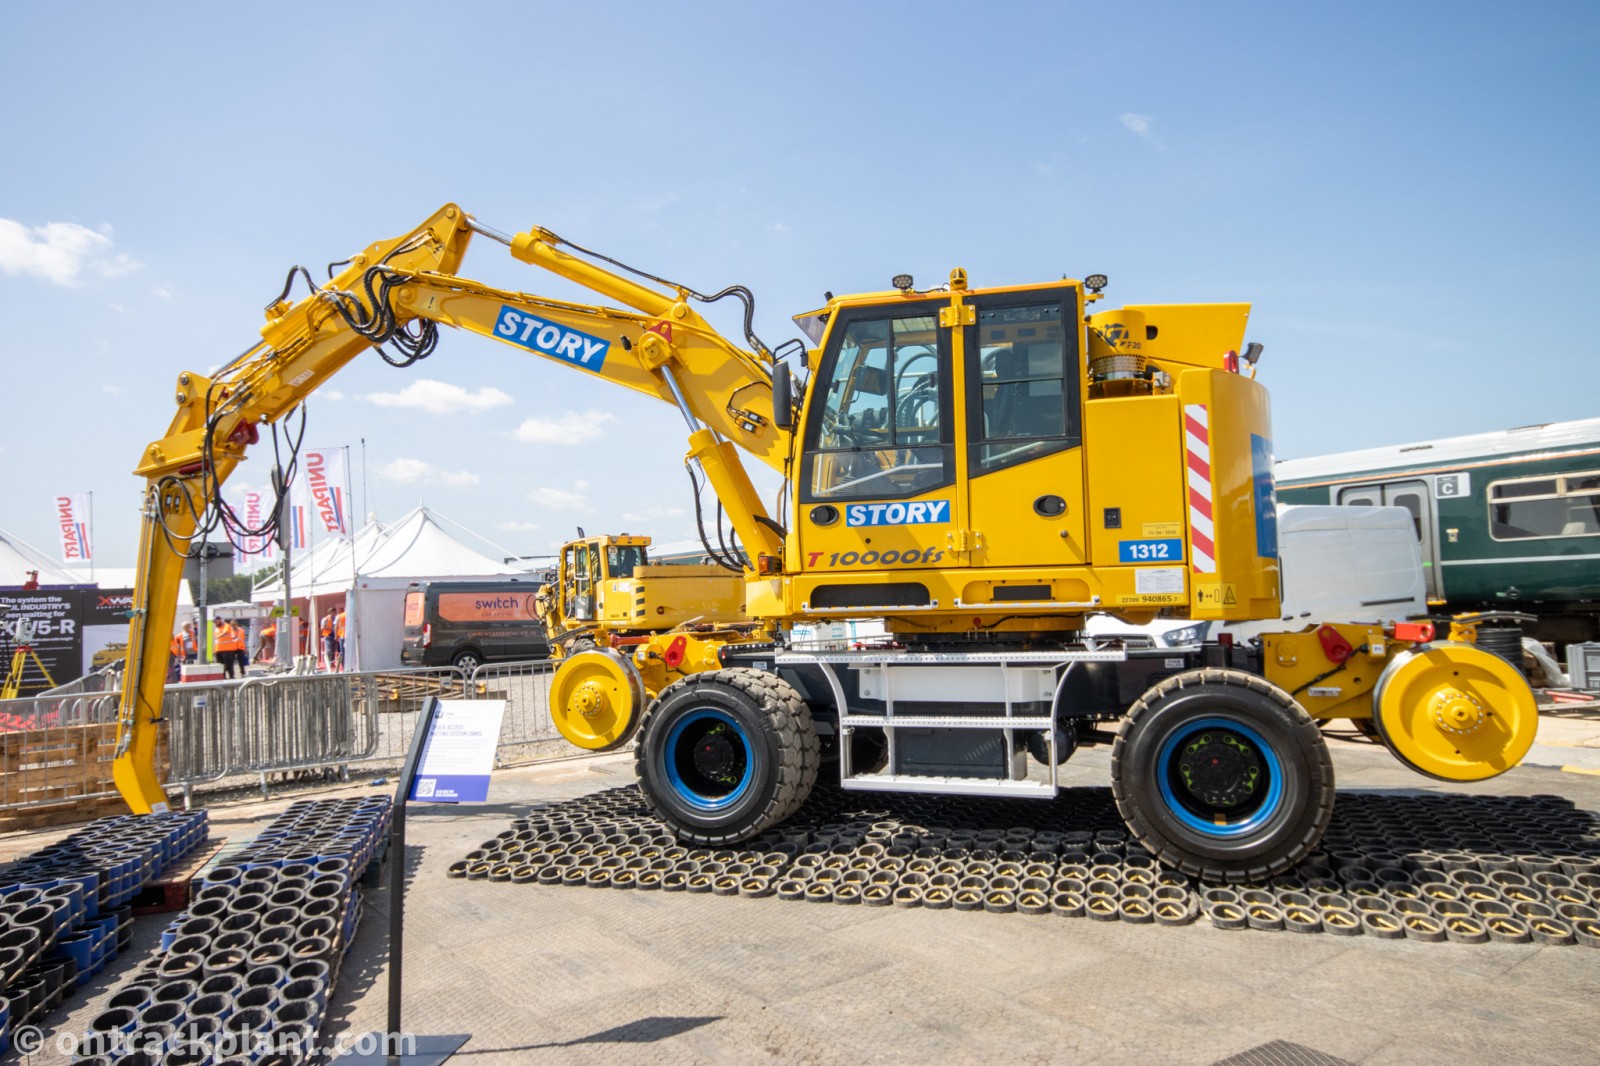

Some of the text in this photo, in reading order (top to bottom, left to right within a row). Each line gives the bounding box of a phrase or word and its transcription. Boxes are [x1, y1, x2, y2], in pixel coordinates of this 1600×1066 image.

[498, 311, 605, 363] STORY
[1442, 483, 1453, 495] C
[849, 501, 947, 526] STORY
[808, 546, 944, 567] T 10000fs
[1129, 543, 1169, 559] 1312
[17, 597, 47, 605] system
[21, 603, 71, 611] INDUSTRY'S
[97, 595, 133, 606] XWA
[475, 596, 519, 610] switch
[22, 611, 52, 619] waiting
